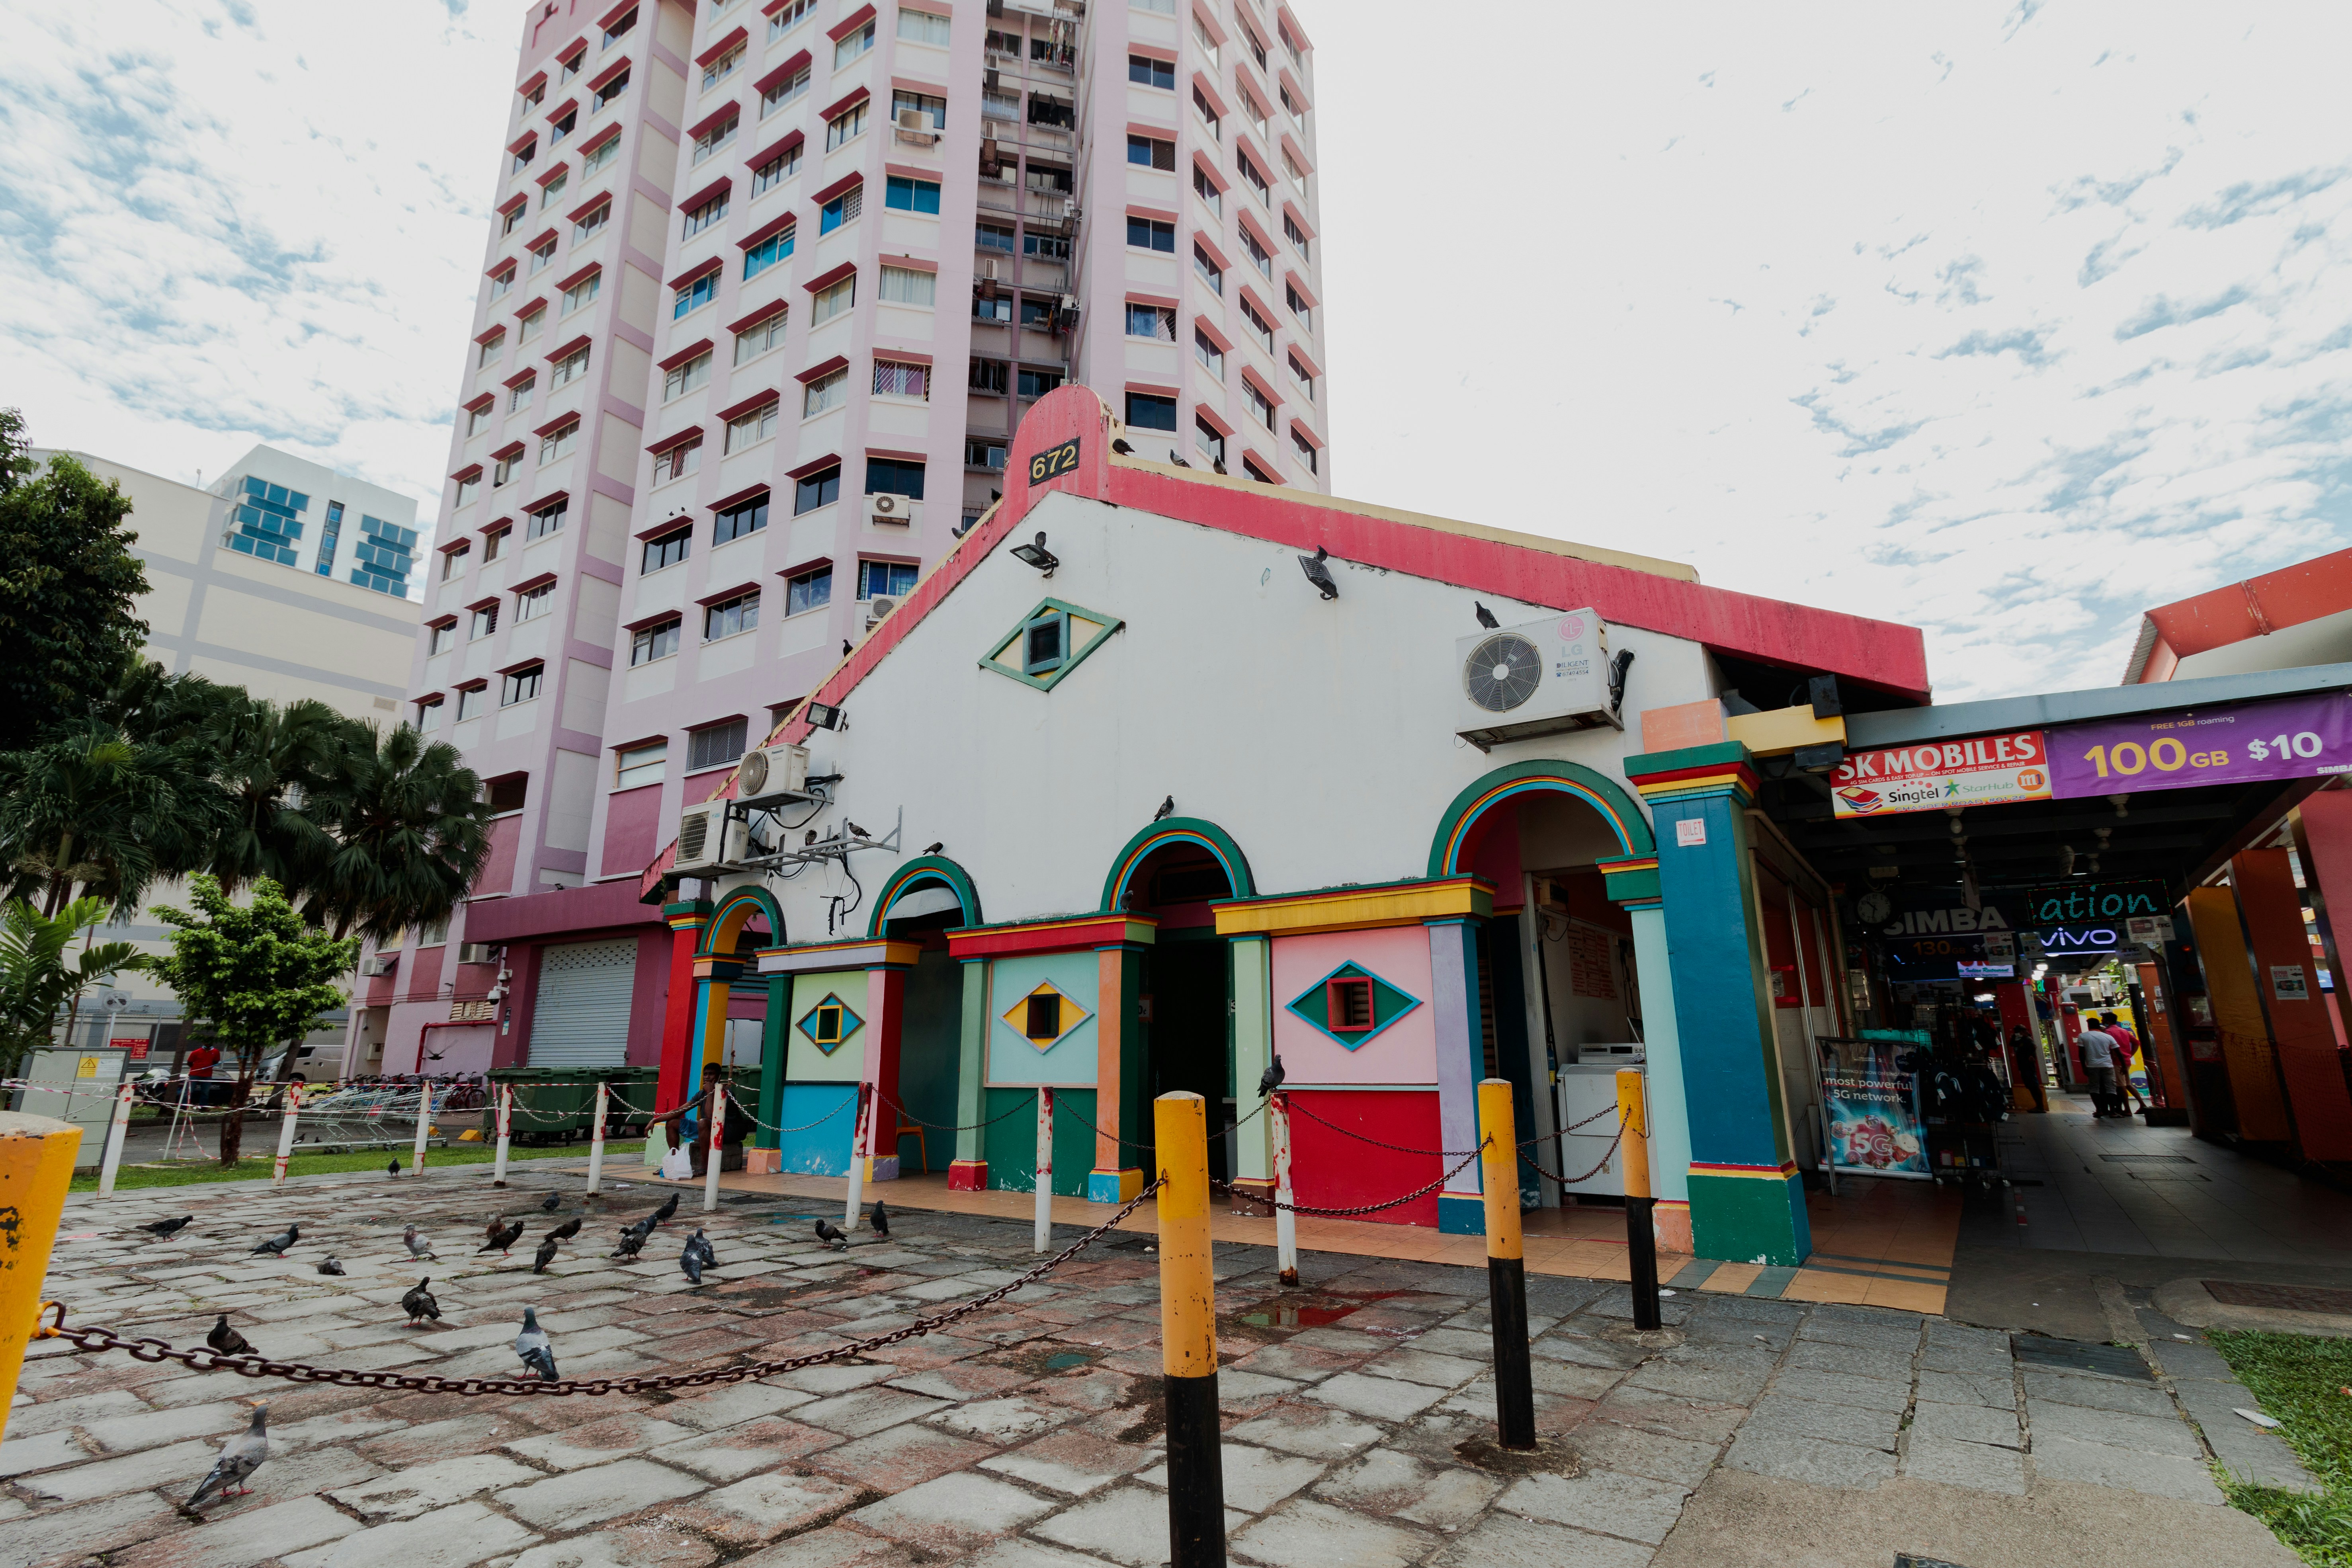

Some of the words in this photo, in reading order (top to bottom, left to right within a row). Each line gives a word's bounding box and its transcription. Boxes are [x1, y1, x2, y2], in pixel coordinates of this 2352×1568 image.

[1033, 445, 1076, 478] 672
[1561, 644, 1582, 657] LG
[2197, 716, 2235, 726] roaming
[2248, 732, 2322, 761] $10
[1838, 754, 1879, 780] SK
[1884, 734, 2036, 775] MOBILES
[1963, 782, 2014, 793] StarHub
[1889, 788, 1939, 803] Singtel
[1895, 802, 1949, 812] CHANDER
[1678, 821, 1701, 836] TOILET
[2033, 884, 2158, 920] ation
[1883, 906, 2008, 935] SIMBA
[2041, 927, 2116, 946] vivo
[1825, 1078, 1855, 1086] most
[1858, 1080, 1913, 1090] powerful
[1834, 1089, 1850, 1099] 5G
[1853, 1092, 1907, 1103] network.
[1855, 1133, 1892, 1156] 5G
